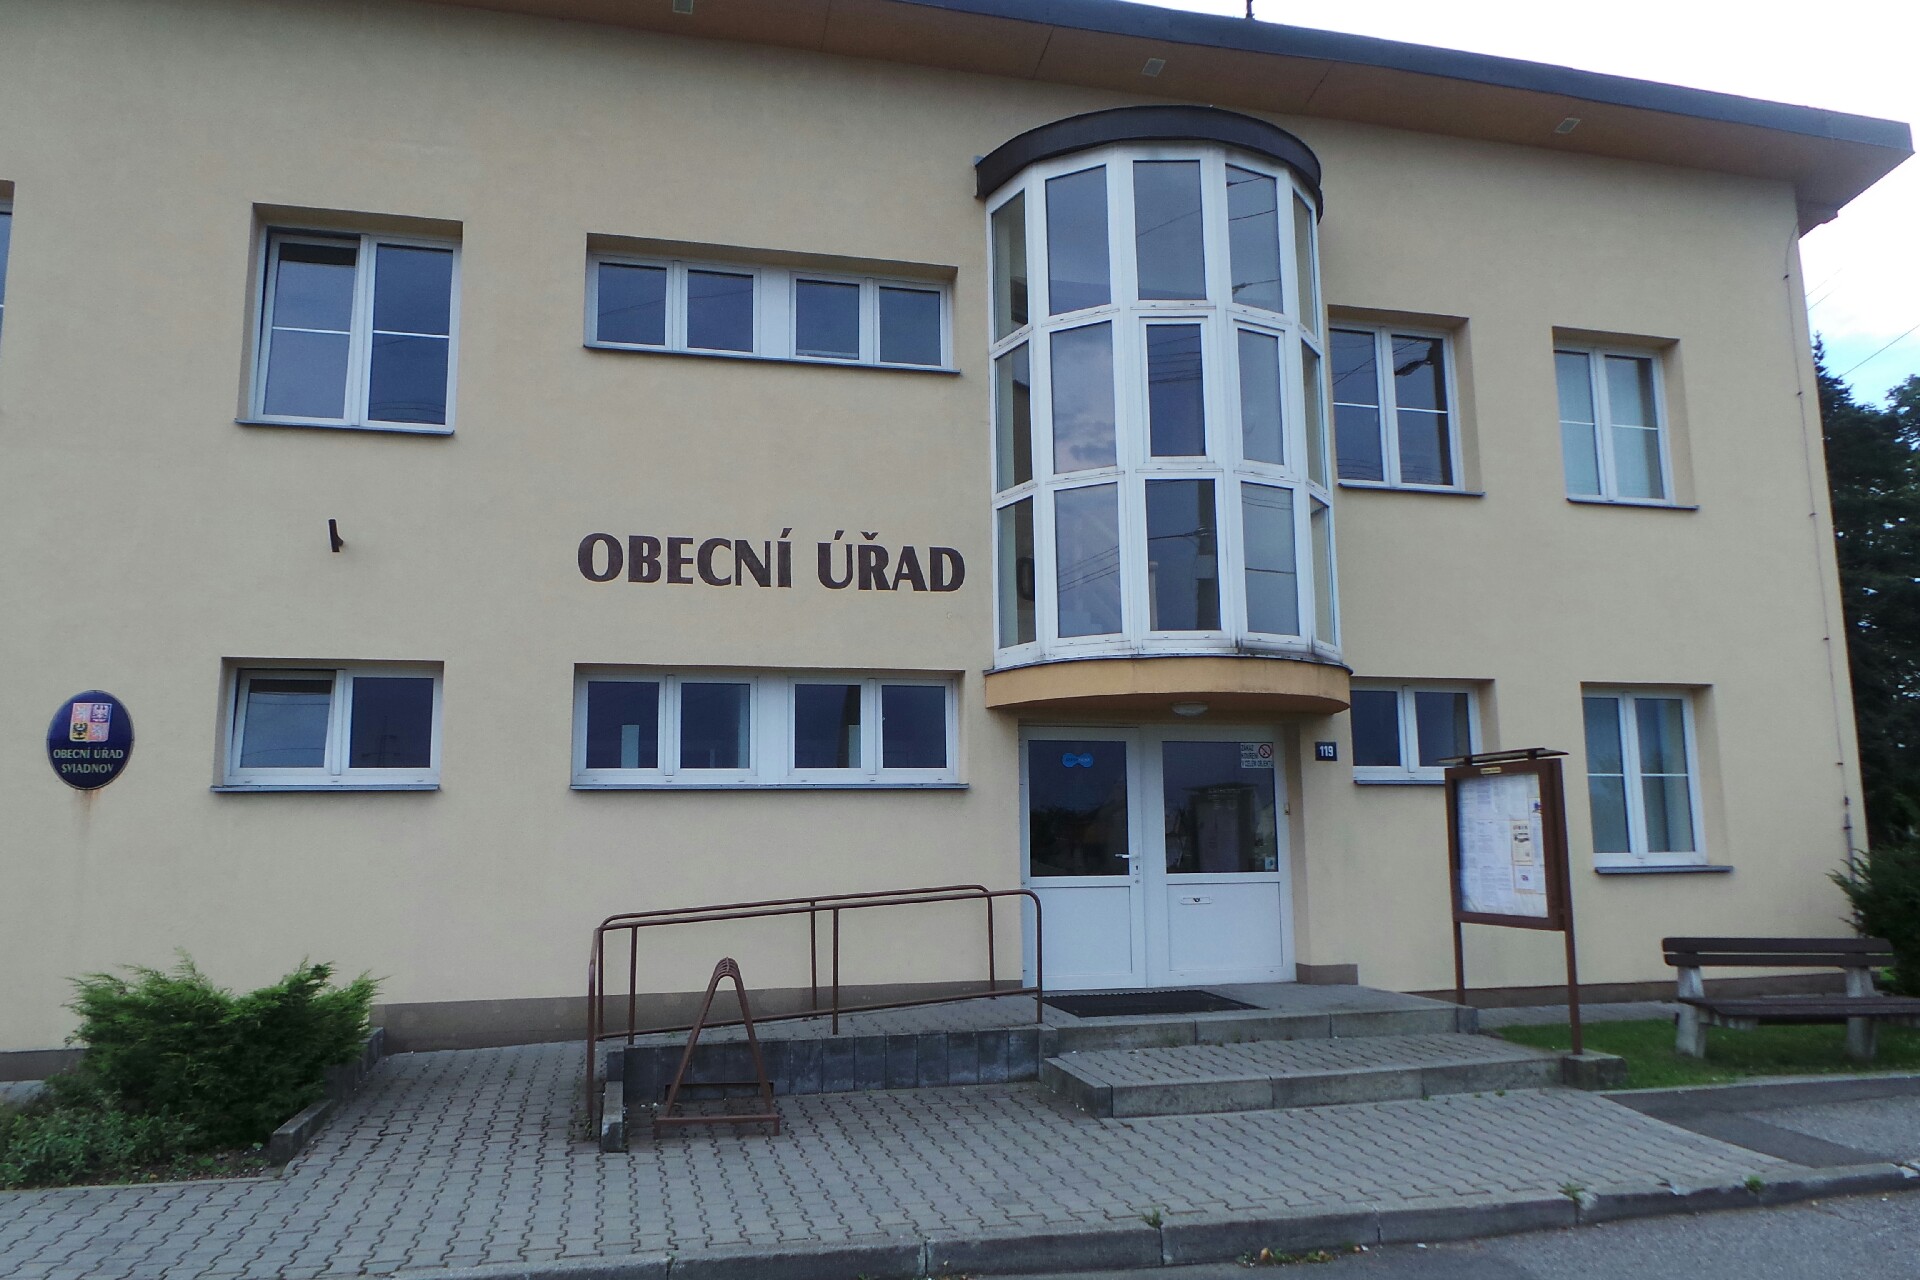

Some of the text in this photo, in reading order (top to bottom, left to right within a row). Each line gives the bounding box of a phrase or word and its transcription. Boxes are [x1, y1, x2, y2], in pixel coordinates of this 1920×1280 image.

[577, 527, 966, 592] OBECNÍ ÚŘAD
[53, 747, 124, 759] OBECNÍ ÚŘAD
[1319, 745, 1334, 757] 119
[62, 763, 114, 774] SVIADNOV
